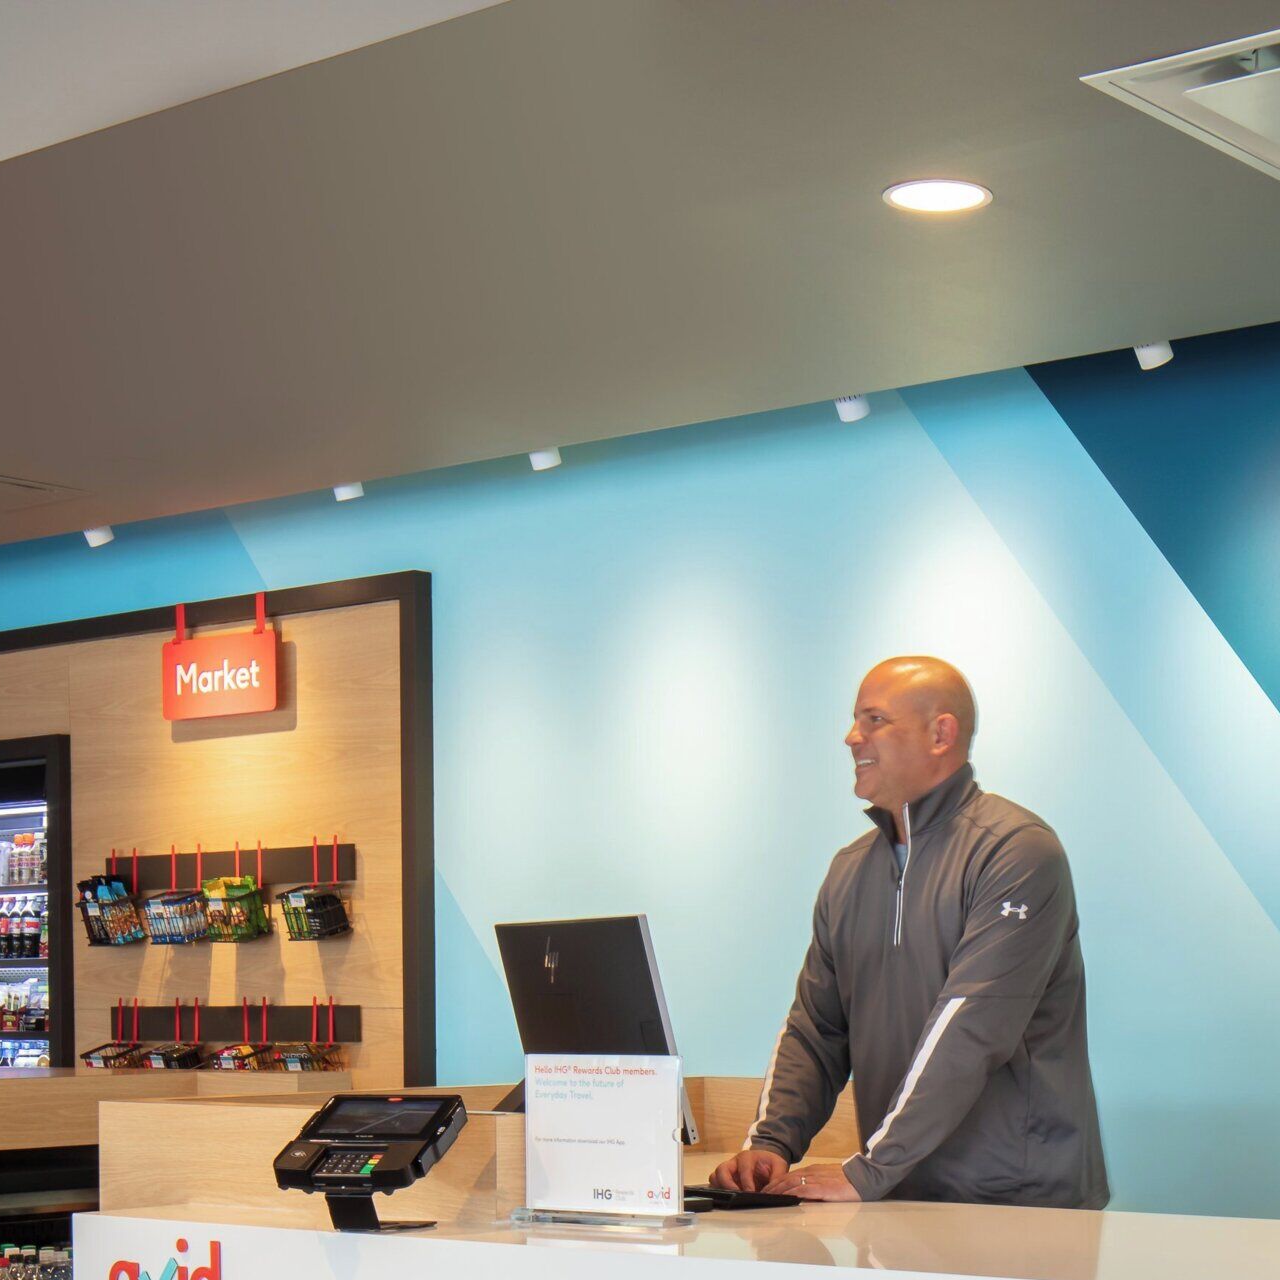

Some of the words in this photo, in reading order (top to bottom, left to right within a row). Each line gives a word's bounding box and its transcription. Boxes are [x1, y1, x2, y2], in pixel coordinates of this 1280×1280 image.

[176, 659, 260, 696] Market
[534, 1065, 552, 1074] Hello
[573, 1066, 603, 1075] Rewards
[604, 1066, 621, 1075] Club
[593, 1188, 613, 1200] IHG
[647, 1186, 671, 1200] avid
